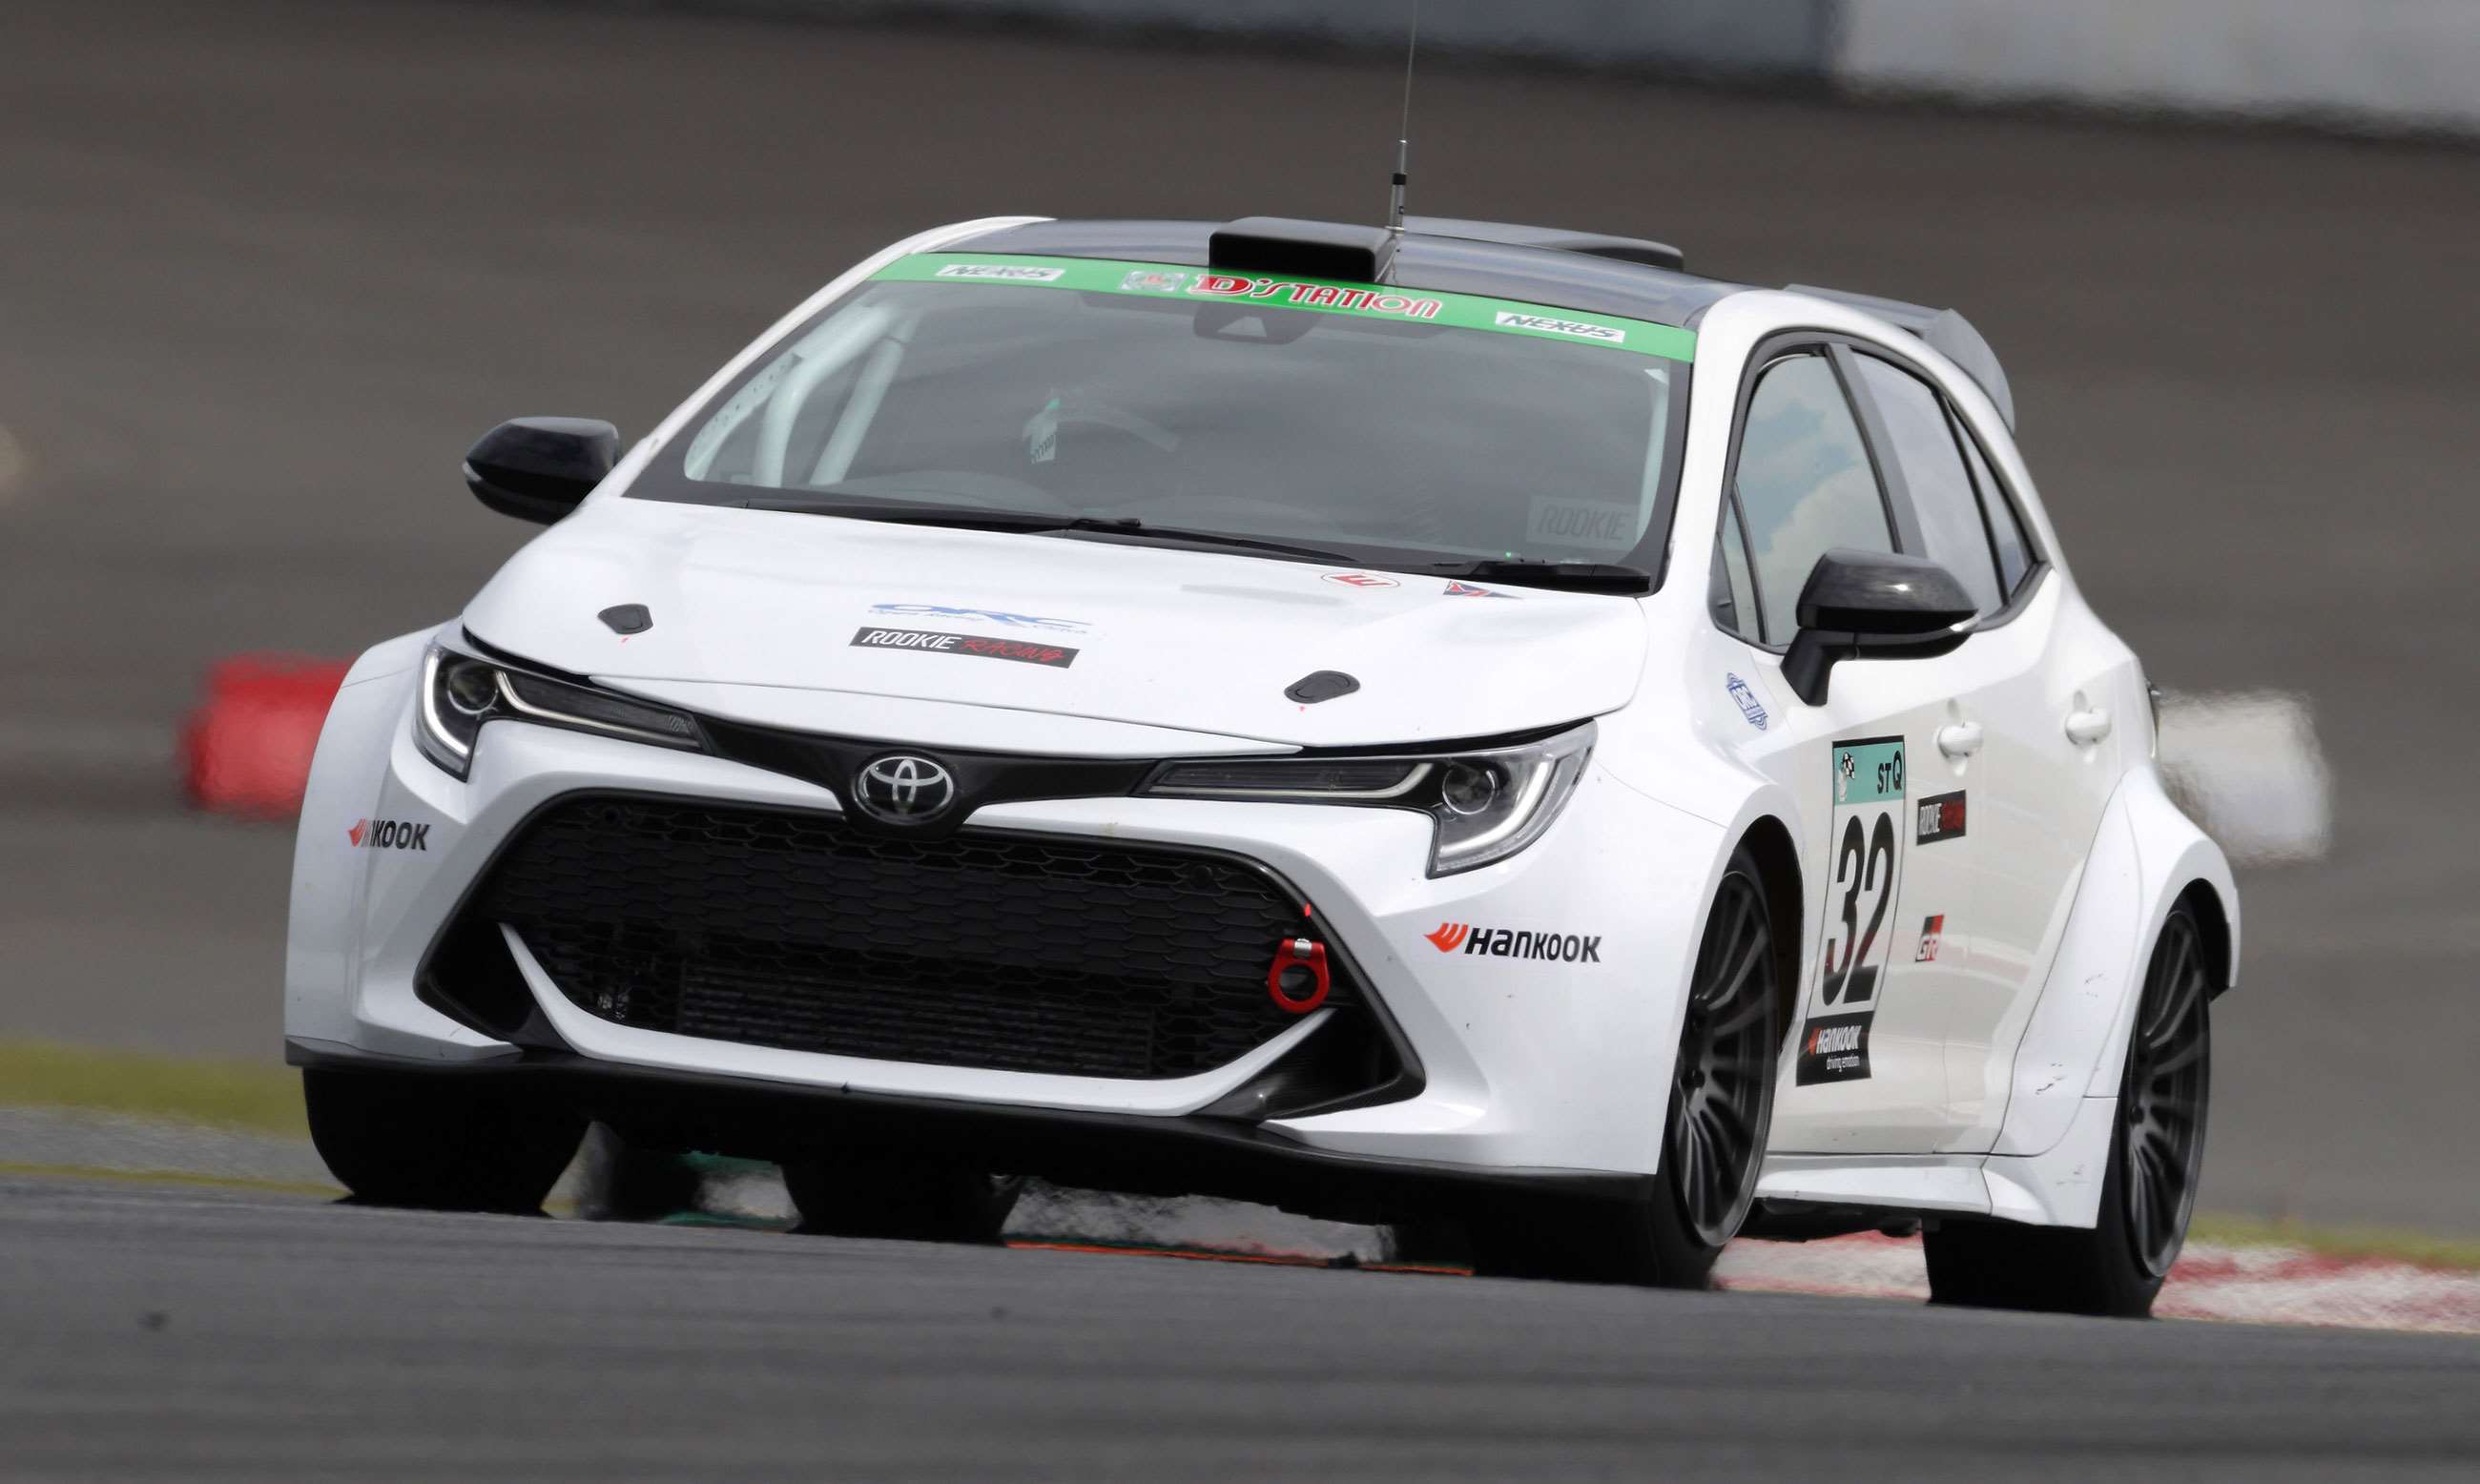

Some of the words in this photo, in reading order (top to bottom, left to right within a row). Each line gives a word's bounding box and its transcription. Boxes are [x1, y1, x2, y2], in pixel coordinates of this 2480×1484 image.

[1503, 314, 1618, 339] NEXUS
[1538, 503, 1632, 541] ROOKIE
[861, 629, 962, 650] ROOKIE
[961, 638, 1066, 662] RACING
[1876, 750, 1903, 794] STQ
[1822, 811, 1896, 1007] 32
